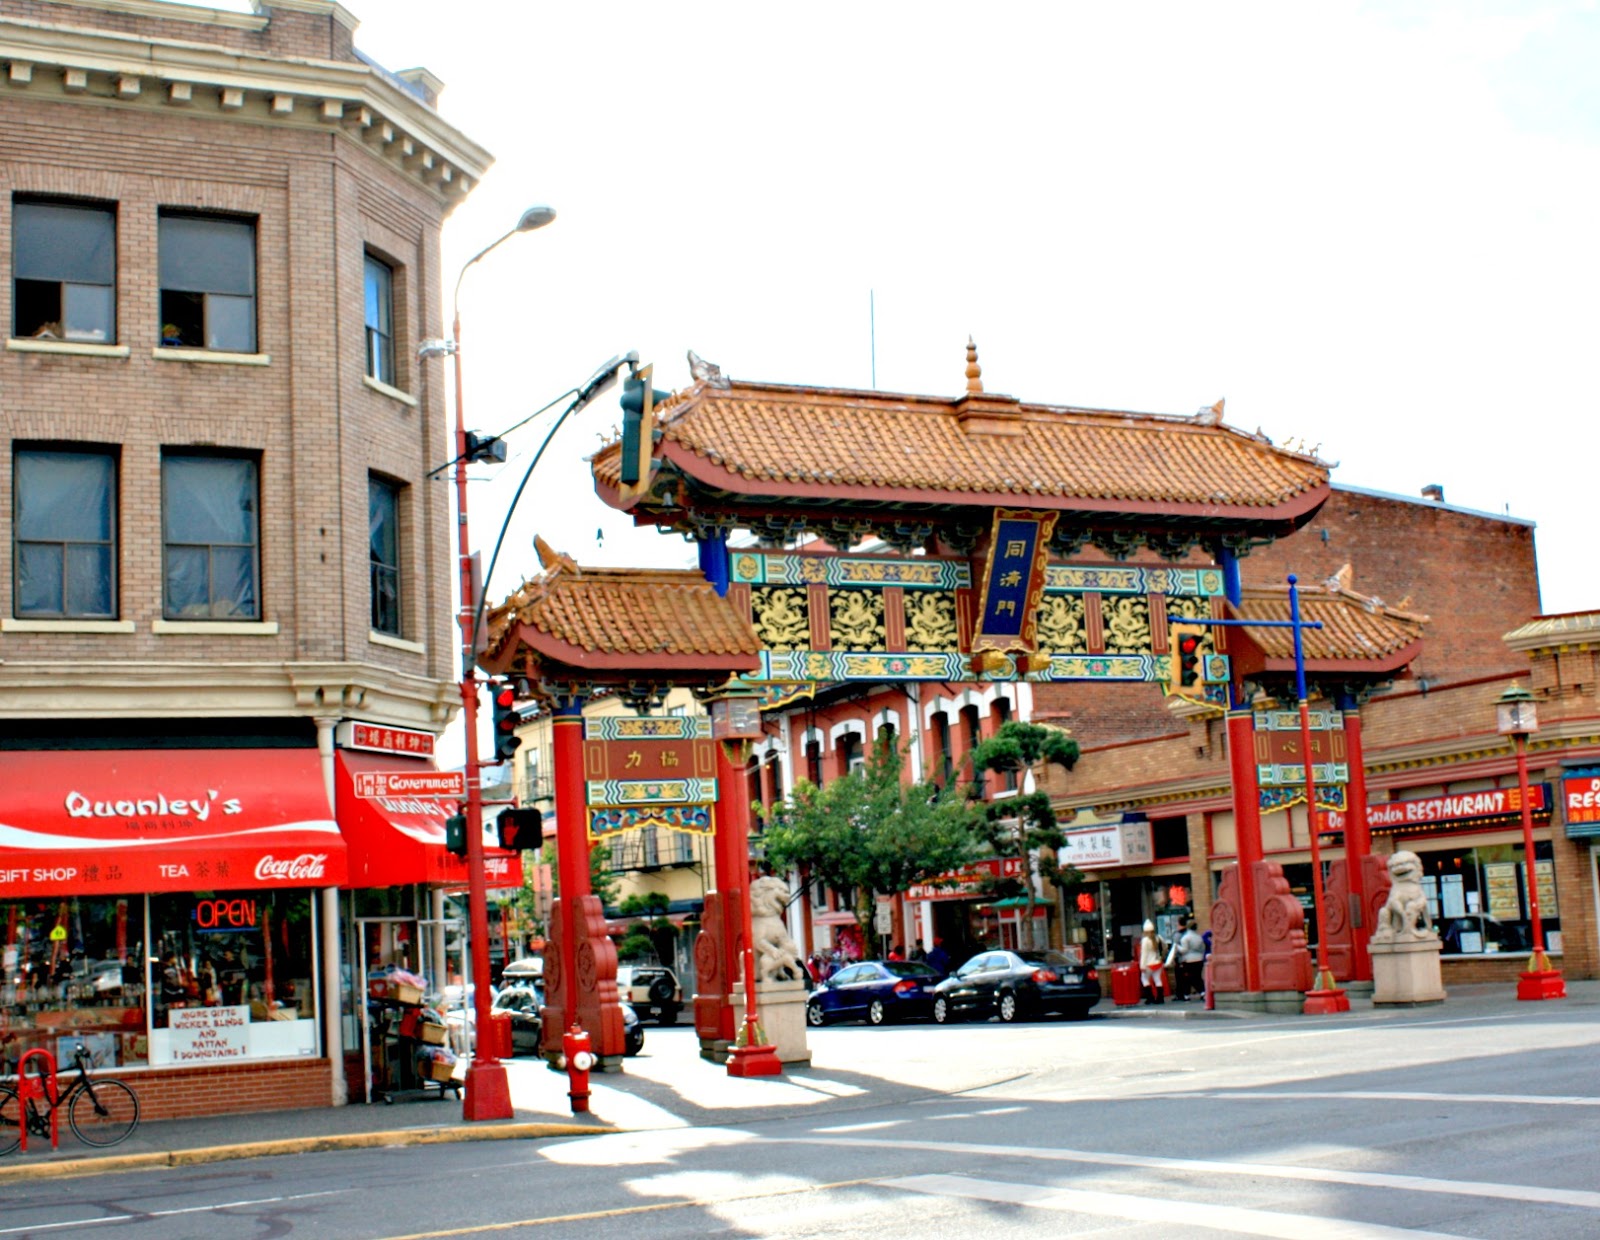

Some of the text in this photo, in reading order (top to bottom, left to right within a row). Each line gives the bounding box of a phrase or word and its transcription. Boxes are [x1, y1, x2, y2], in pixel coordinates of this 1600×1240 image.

[388, 774, 461, 791] Government
[1406, 792, 1505, 820] RESTAURANT
[0, 867, 77, 883] GIFT SHOP
[159, 864, 189, 877] TEA
[197, 899, 256, 927] OPEN
[181, 1010, 208, 1020] MORE
[199, 1030, 217, 1039] AND
[192, 1038, 228, 1049] RATTAN
[181, 1049, 238, 1060] DOWNSTAIRS
